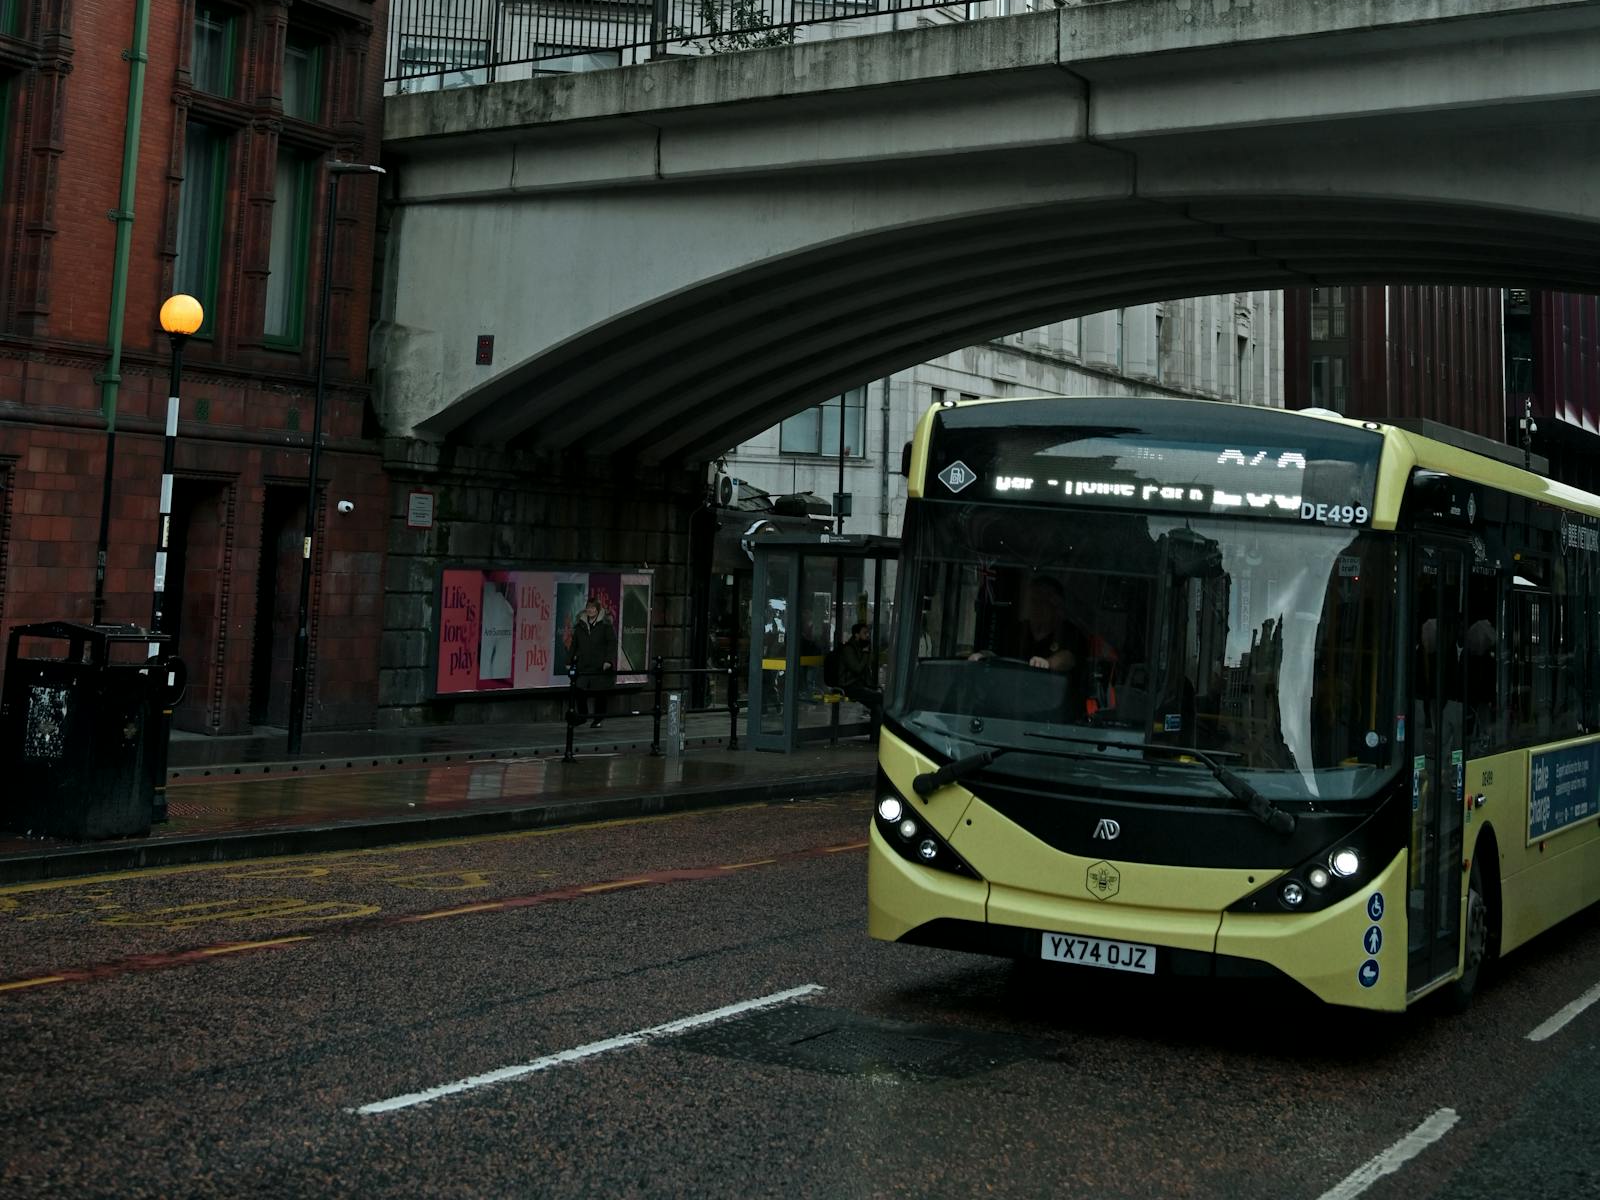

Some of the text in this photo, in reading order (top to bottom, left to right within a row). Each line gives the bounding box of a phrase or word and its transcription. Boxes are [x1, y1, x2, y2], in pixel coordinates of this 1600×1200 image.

[1300, 502, 1369, 524] DE499
[444, 585, 466, 609] Life
[521, 585, 541, 609] Life
[466, 599, 476, 622] is
[540, 599, 550, 622] is
[449, 647, 475, 676] play
[526, 645, 548, 672] play
[1535, 757, 1549, 792] take
[1530, 791, 1551, 831] charge
[1051, 936, 1147, 969] YX74 OJZ
